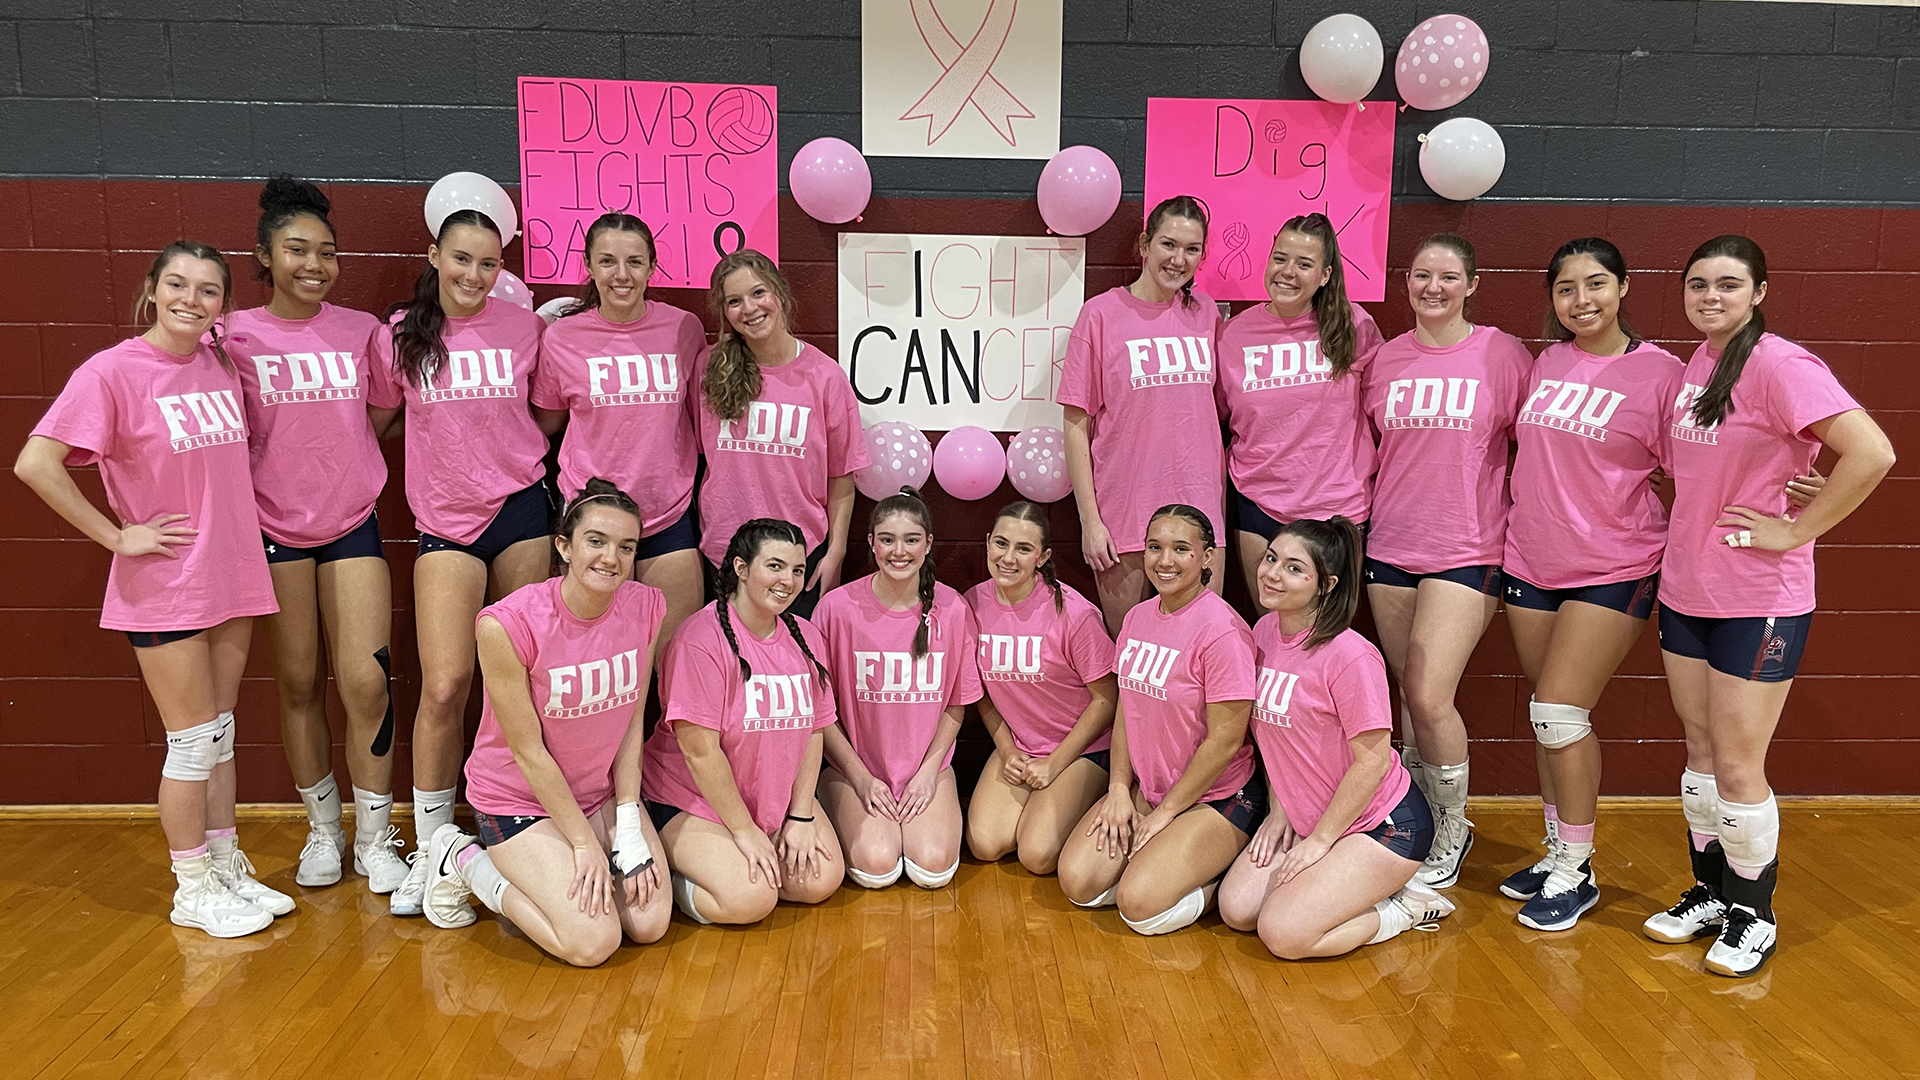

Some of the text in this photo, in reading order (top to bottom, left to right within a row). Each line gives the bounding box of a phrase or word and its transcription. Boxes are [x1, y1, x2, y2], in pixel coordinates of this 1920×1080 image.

[522, 81, 697, 147] FDUVB
[525, 150, 735, 216] FIGHTS
[865, 243, 1077, 320] FIGHT
[251, 352, 360, 395] FDU
[586, 354, 679, 396] FDU
[850, 325, 1075, 405] CANCER
[1125, 336, 1212, 378] FDU
[1242, 340, 1333, 382] FDU
[261, 387, 361, 405] VOLLEYBALL
[421, 387, 517, 402] VOLLEYBALL
[590, 392, 680, 405] VOLLEYBALL
[1131, 373, 1212, 388] VOLLEYBAL
[1242, 373, 1328, 391] VOLLEYBAL
[1384, 378, 1480, 419] FDU
[154, 390, 243, 441] FDU
[1384, 418, 1473, 430] VOLLEYBALL
[1521, 380, 1627, 427] FDU
[717, 440, 805, 457] VOLLEYBALL
[548, 648, 638, 709] FDU
[854, 651, 945, 692] FDU
[1118, 638, 1181, 687] FDU
[544, 690, 638, 717] VOLLEYBALL
[743, 673, 814, 719] FDU
[1256, 667, 1300, 714] DU
